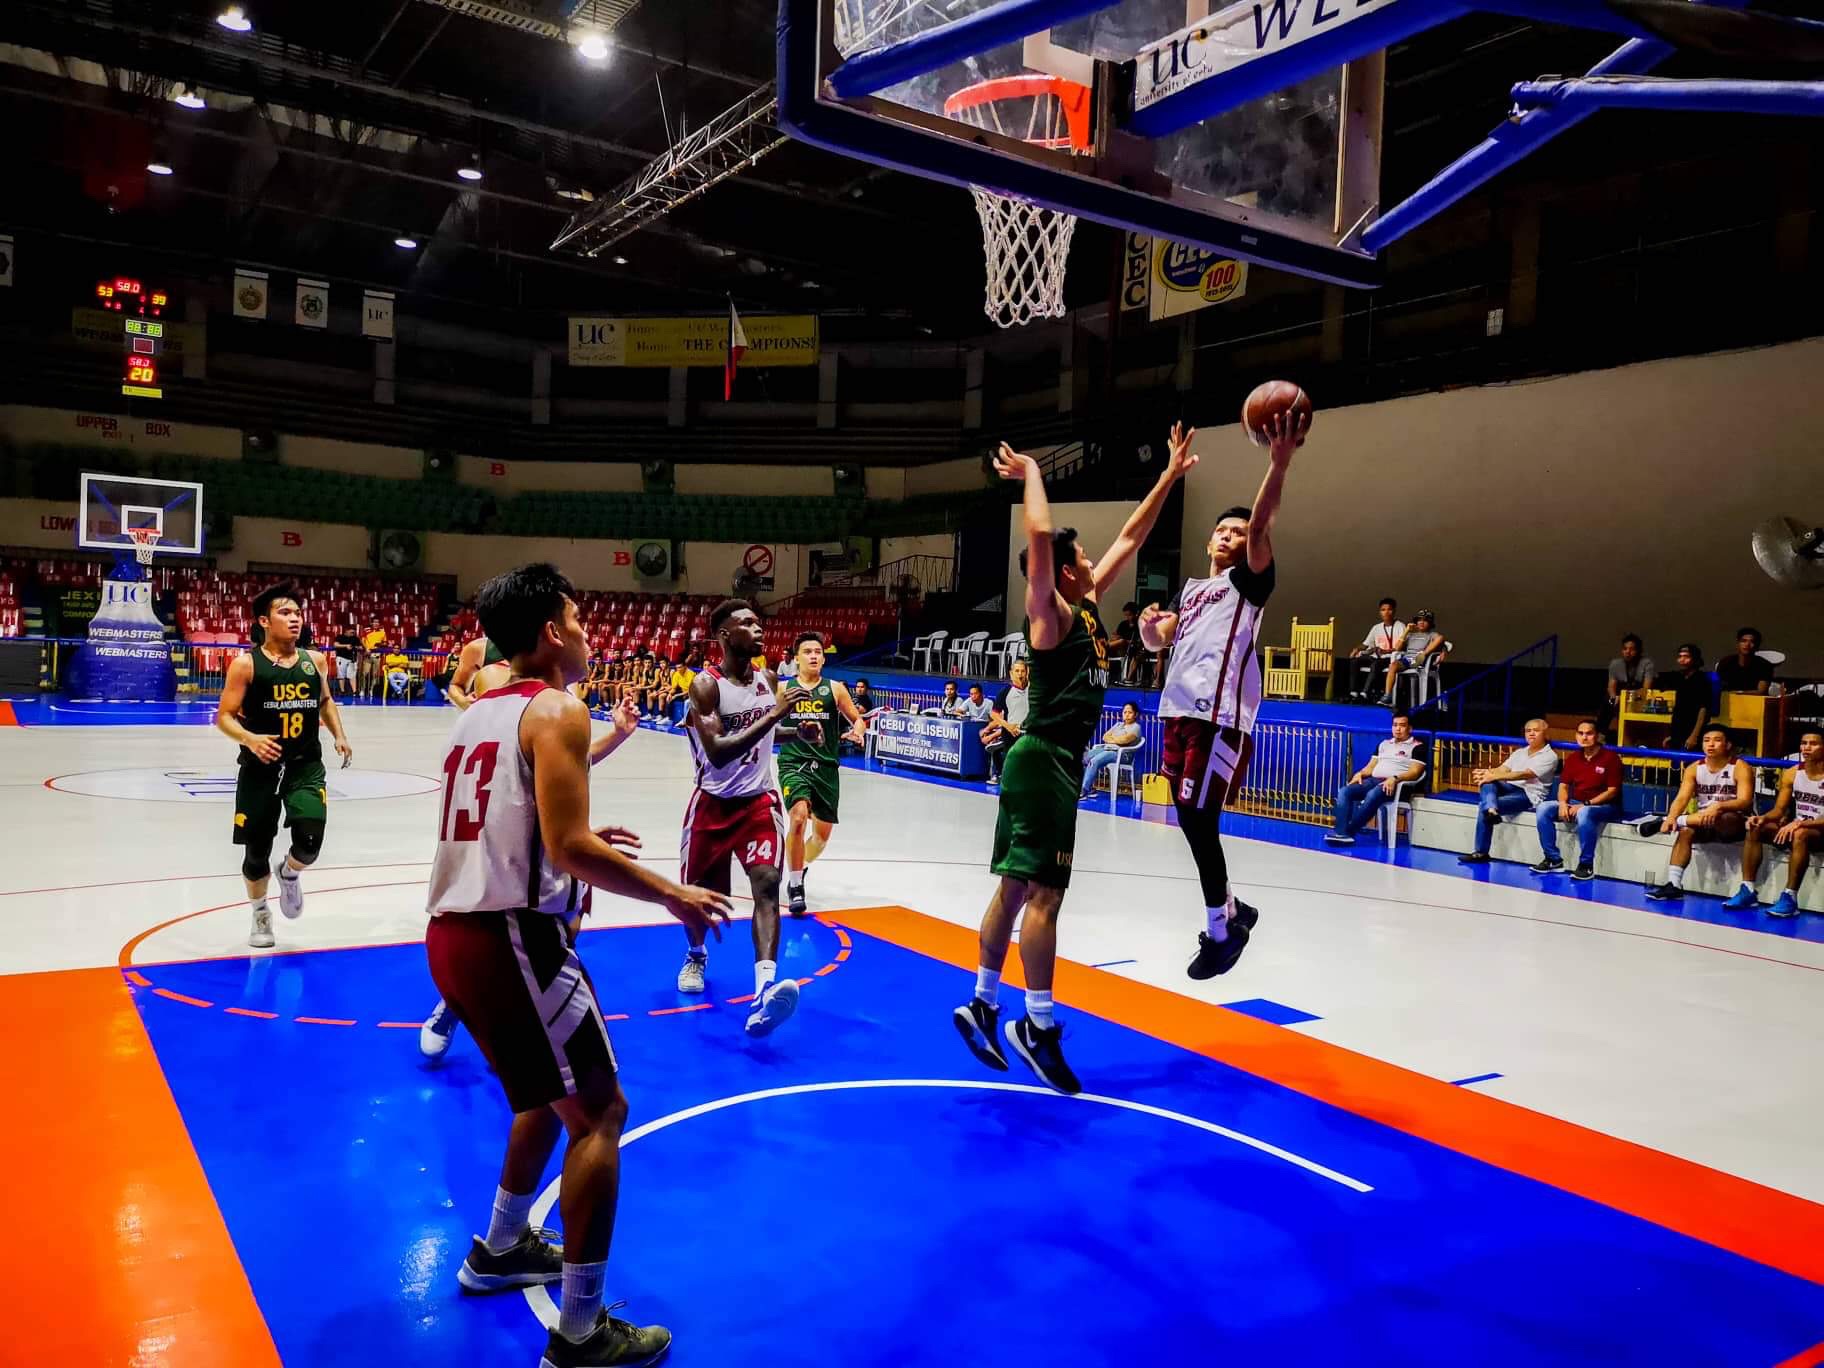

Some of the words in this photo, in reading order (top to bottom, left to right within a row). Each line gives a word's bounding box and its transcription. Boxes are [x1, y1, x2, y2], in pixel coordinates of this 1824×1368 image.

[1151, 29, 1207, 91] UC
[1206, 263, 1235, 289] 100
[98, 286, 113, 297] 53
[152, 294, 167, 306] 39
[578, 323, 615, 348] UC
[682, 338, 714, 351] THE
[718, 336, 816, 352] CMPIONS!
[129, 367, 155, 382] 20
[146, 422, 171, 437] BOX
[491, 463, 505, 476] B
[280, 531, 302, 546] B
[613, 551, 631, 566] B
[88, 627, 164, 639] WEBMASTERS
[96, 647, 168, 659] WEBMASTERS
[273, 682, 311, 701] USC
[795, 700, 824, 713] USC
[280, 712, 304, 739] 18
[880, 718, 905, 732] CEBU
[907, 721, 959, 740] COLISEUM
[896, 744, 959, 765] WEBMASTERS
[440, 741, 500, 841] 13
[746, 839, 772, 874] 24
